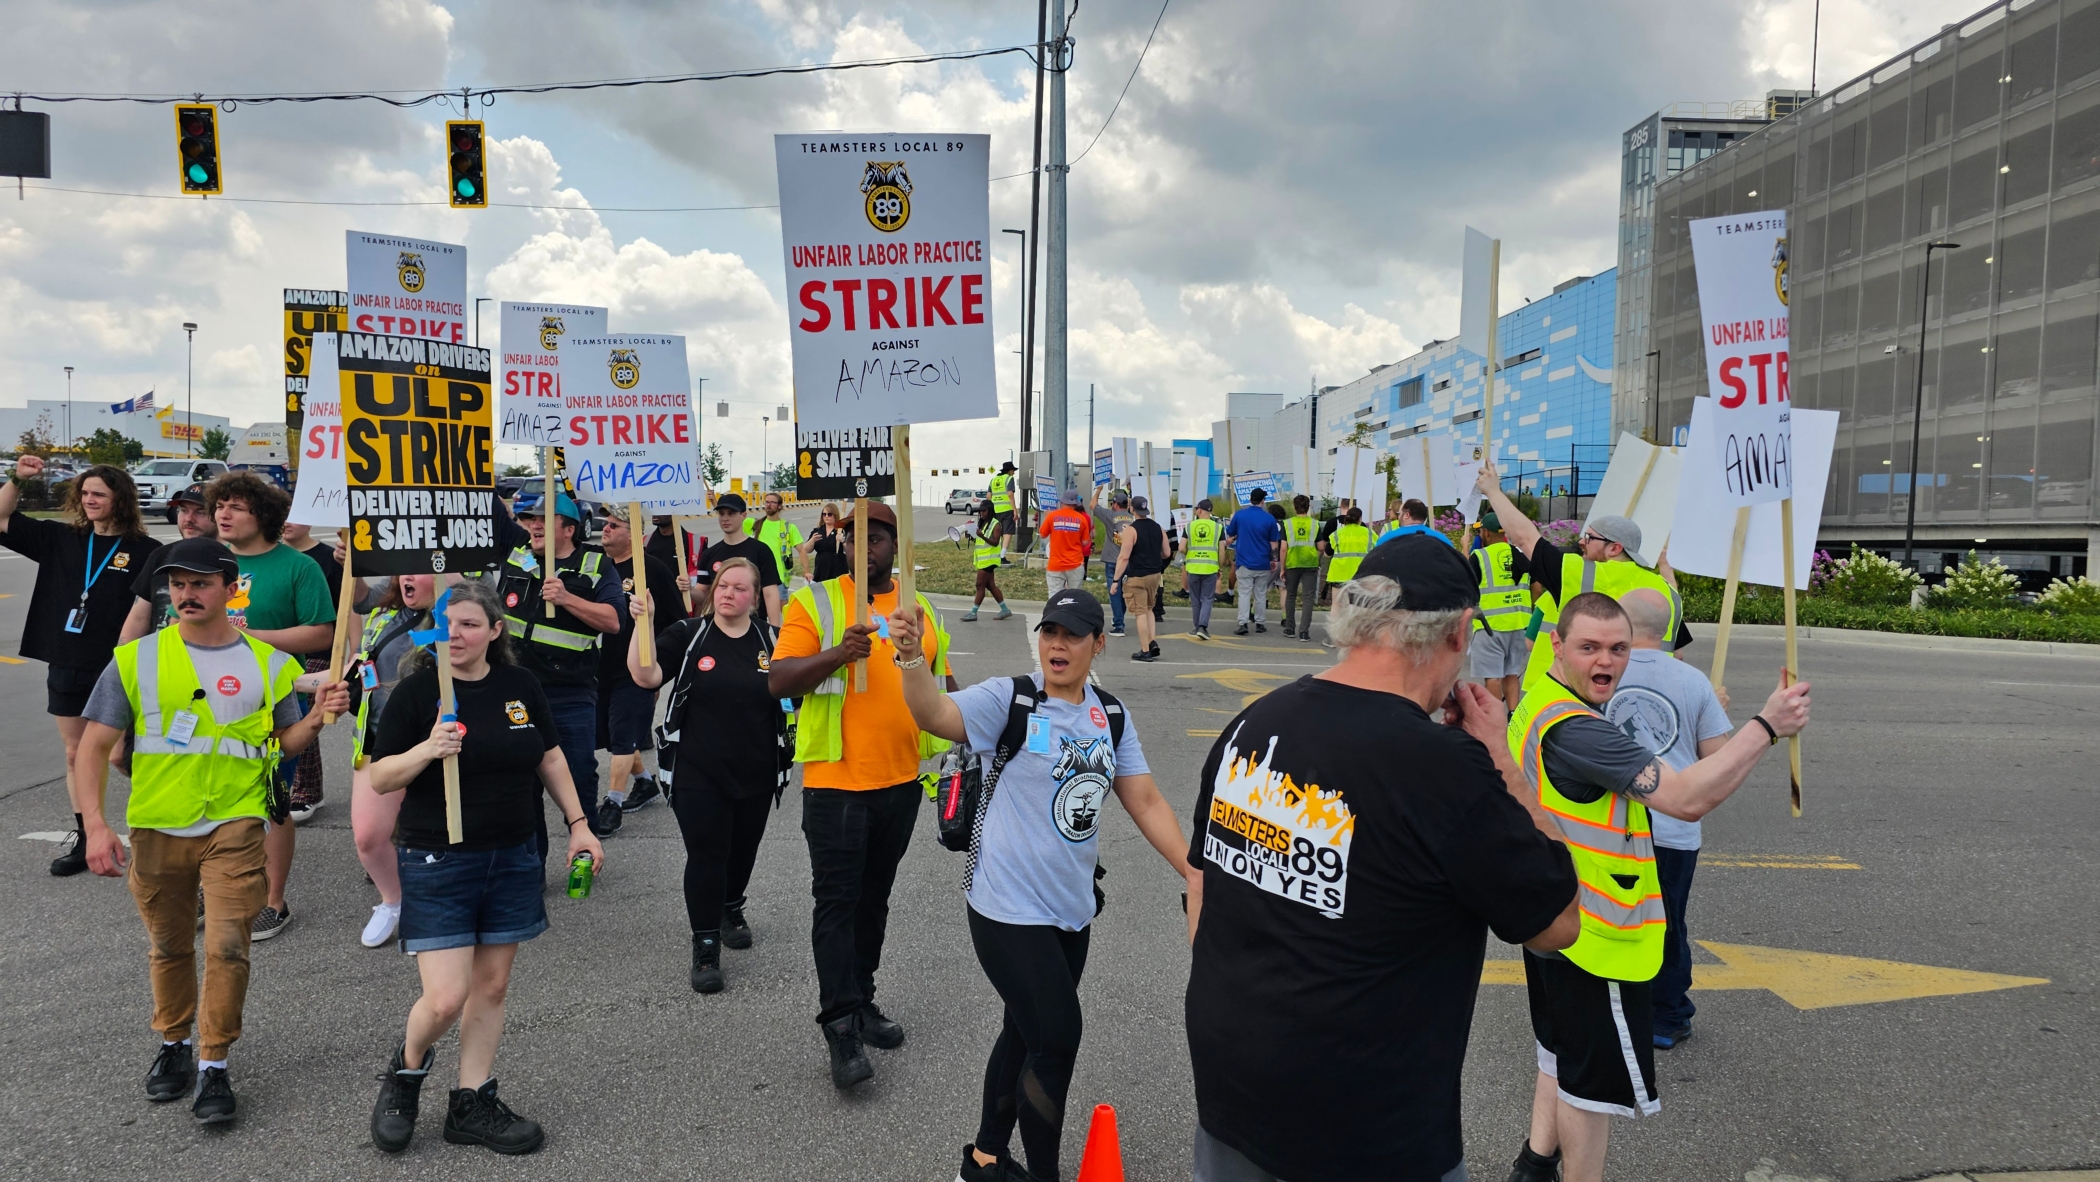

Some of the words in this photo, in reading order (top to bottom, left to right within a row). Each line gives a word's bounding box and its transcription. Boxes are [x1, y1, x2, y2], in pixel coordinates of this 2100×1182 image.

[801, 142, 887, 153] TEAMSTERS
[895, 142, 939, 153] LOCAL
[946, 141, 965, 152] 89
[1630, 125, 1649, 151] 285
[875, 198, 901, 217] 89
[362, 236, 412, 249] TEAMSTERS
[416, 243, 440, 253] LOCAL
[792, 244, 852, 268] UNFAIR
[858, 243, 909, 266] LABOR
[914, 240, 982, 264] PRACTICE
[405, 272, 420, 285] 89
[285, 290, 338, 305] AMAZON
[353, 293, 391, 309] UNFAIR
[394, 297, 423, 312] LABOR
[426, 301, 463, 316] PRACTICE
[513, 305, 553, 313] TEAMSTERS
[798, 274, 984, 333] STRIKE
[871, 339, 920, 351] AGAINST
[1712, 319, 1765, 346] UNFAIR
[1769, 317, 1789, 340] LAB
[340, 333, 426, 364] AMAZON
[428, 342, 490, 372] DRIVERS
[504, 353, 532, 366] UNFAIR
[415, 364, 441, 376] on
[504, 370, 561, 398] STRI
[616, 369, 634, 381] 89
[835, 356, 961, 403] AMAZON
[1718, 351, 1790, 409] STR
[354, 373, 484, 421] ULP
[566, 395, 603, 409] UNFAIR
[606, 395, 639, 408] LABOR
[642, 394, 687, 408] PRACTICE
[171, 425, 199, 438] DHL
[502, 408, 562, 443] AMAZ
[569, 414, 690, 446] STRIKE
[798, 428, 858, 449] DELIVER
[860, 426, 889, 448] FAIR
[347, 418, 492, 486] STRIKE
[614, 450, 647, 458] AGAINST
[798, 451, 813, 478] &
[816, 450, 862, 478] SAFE
[865, 450, 895, 477] JOB
[1725, 432, 1790, 496] AMA
[576, 459, 690, 493] AMAZON
[1235, 479, 1274, 489] UNIONIZING
[351, 490, 433, 516] DELIVER
[436, 491, 467, 516] FAIR
[469, 491, 494, 515] PAY
[353, 519, 373, 551] &
[377, 518, 438, 550] SAFE
[442, 518, 494, 549] JOBS!
[1211, 798, 1290, 852] TEAMSTERS
[1245, 838, 1288, 871] LOCAL
[1291, 836, 1344, 883] 89
[1204, 836, 1264, 885] UNION
[1278, 872, 1342, 910] YES
